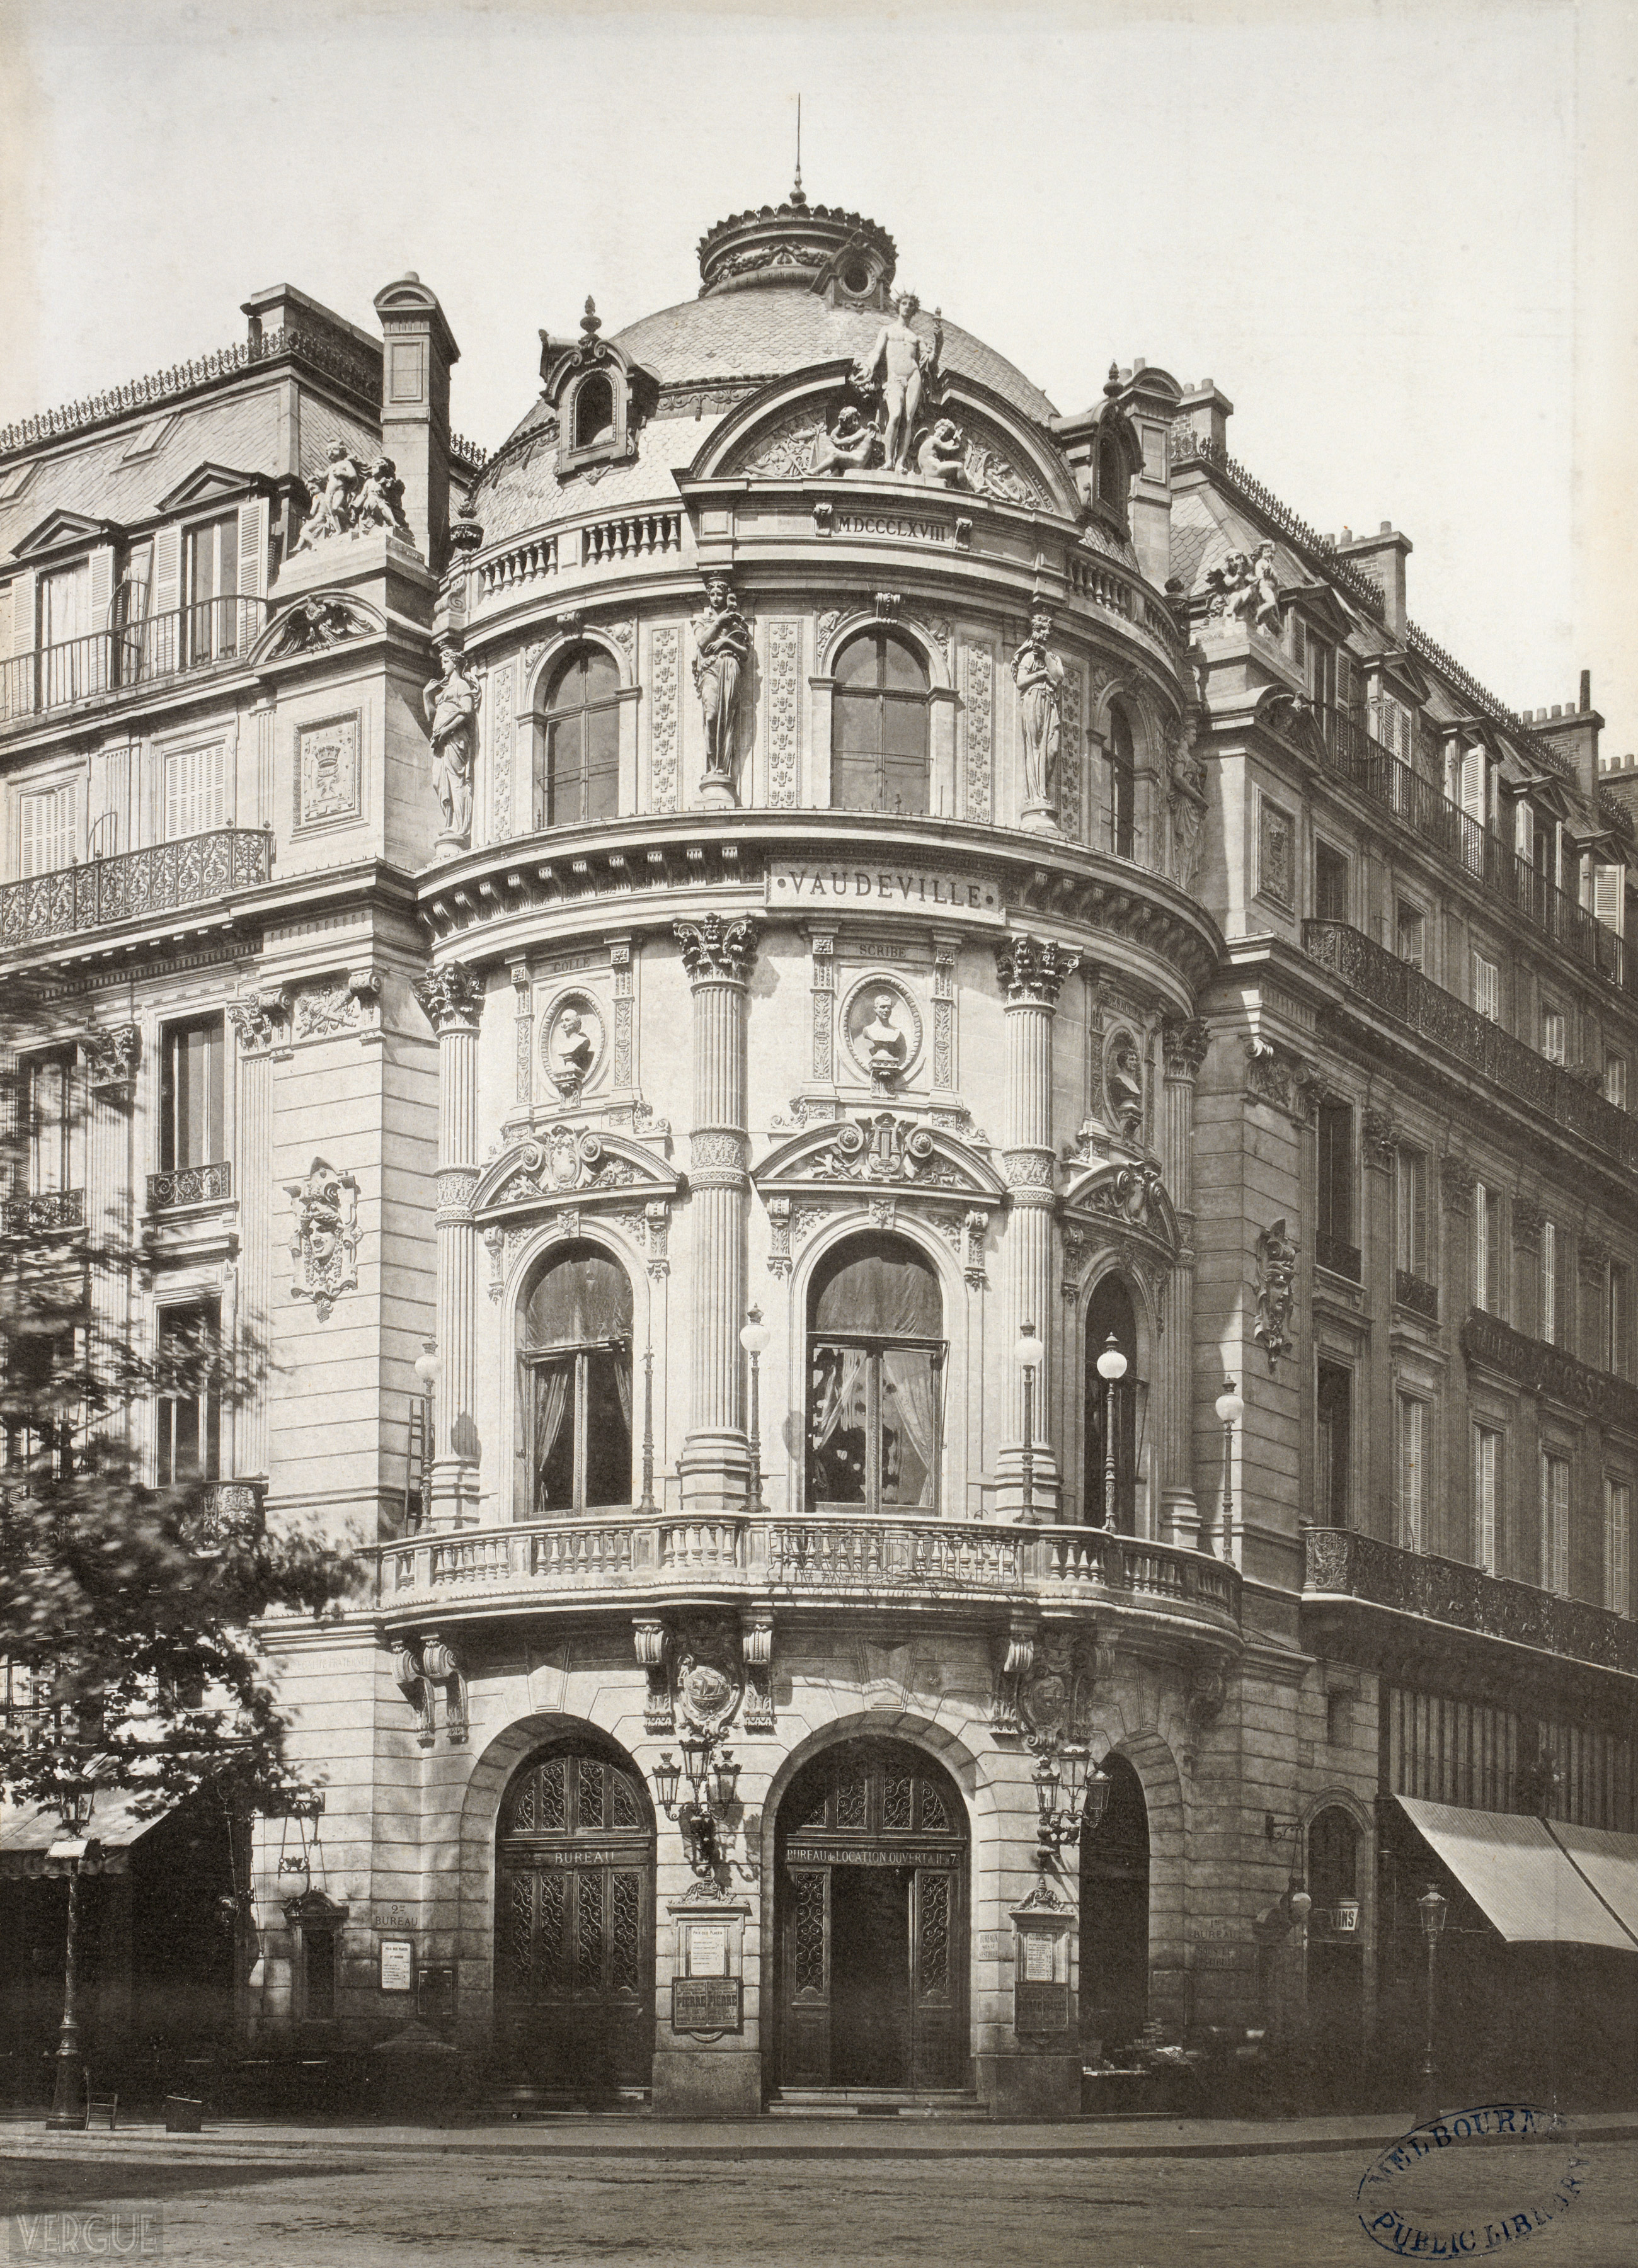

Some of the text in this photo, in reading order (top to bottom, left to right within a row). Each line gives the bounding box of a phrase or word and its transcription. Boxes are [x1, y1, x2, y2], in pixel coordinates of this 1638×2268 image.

[839, 516, 946, 542] MDCCCLXVIII
[789, 871, 982, 909] VAUDEVILLE
[859, 945, 907, 958] SCRIBE
[554, 957, 590, 973] COLLE
[555, 1851, 614, 1864] BUREAU
[786, 1849, 827, 1861] BUREAU
[827, 1853, 835, 1861] de
[836, 1850, 886, 1862] LOCATION
[889, 1852, 927, 1864] OUVERT
[375, 1916, 418, 1927] BUREAU
[1332, 1910, 1354, 1927] VINS
[1194, 1930, 1236, 1939] BUREAU
